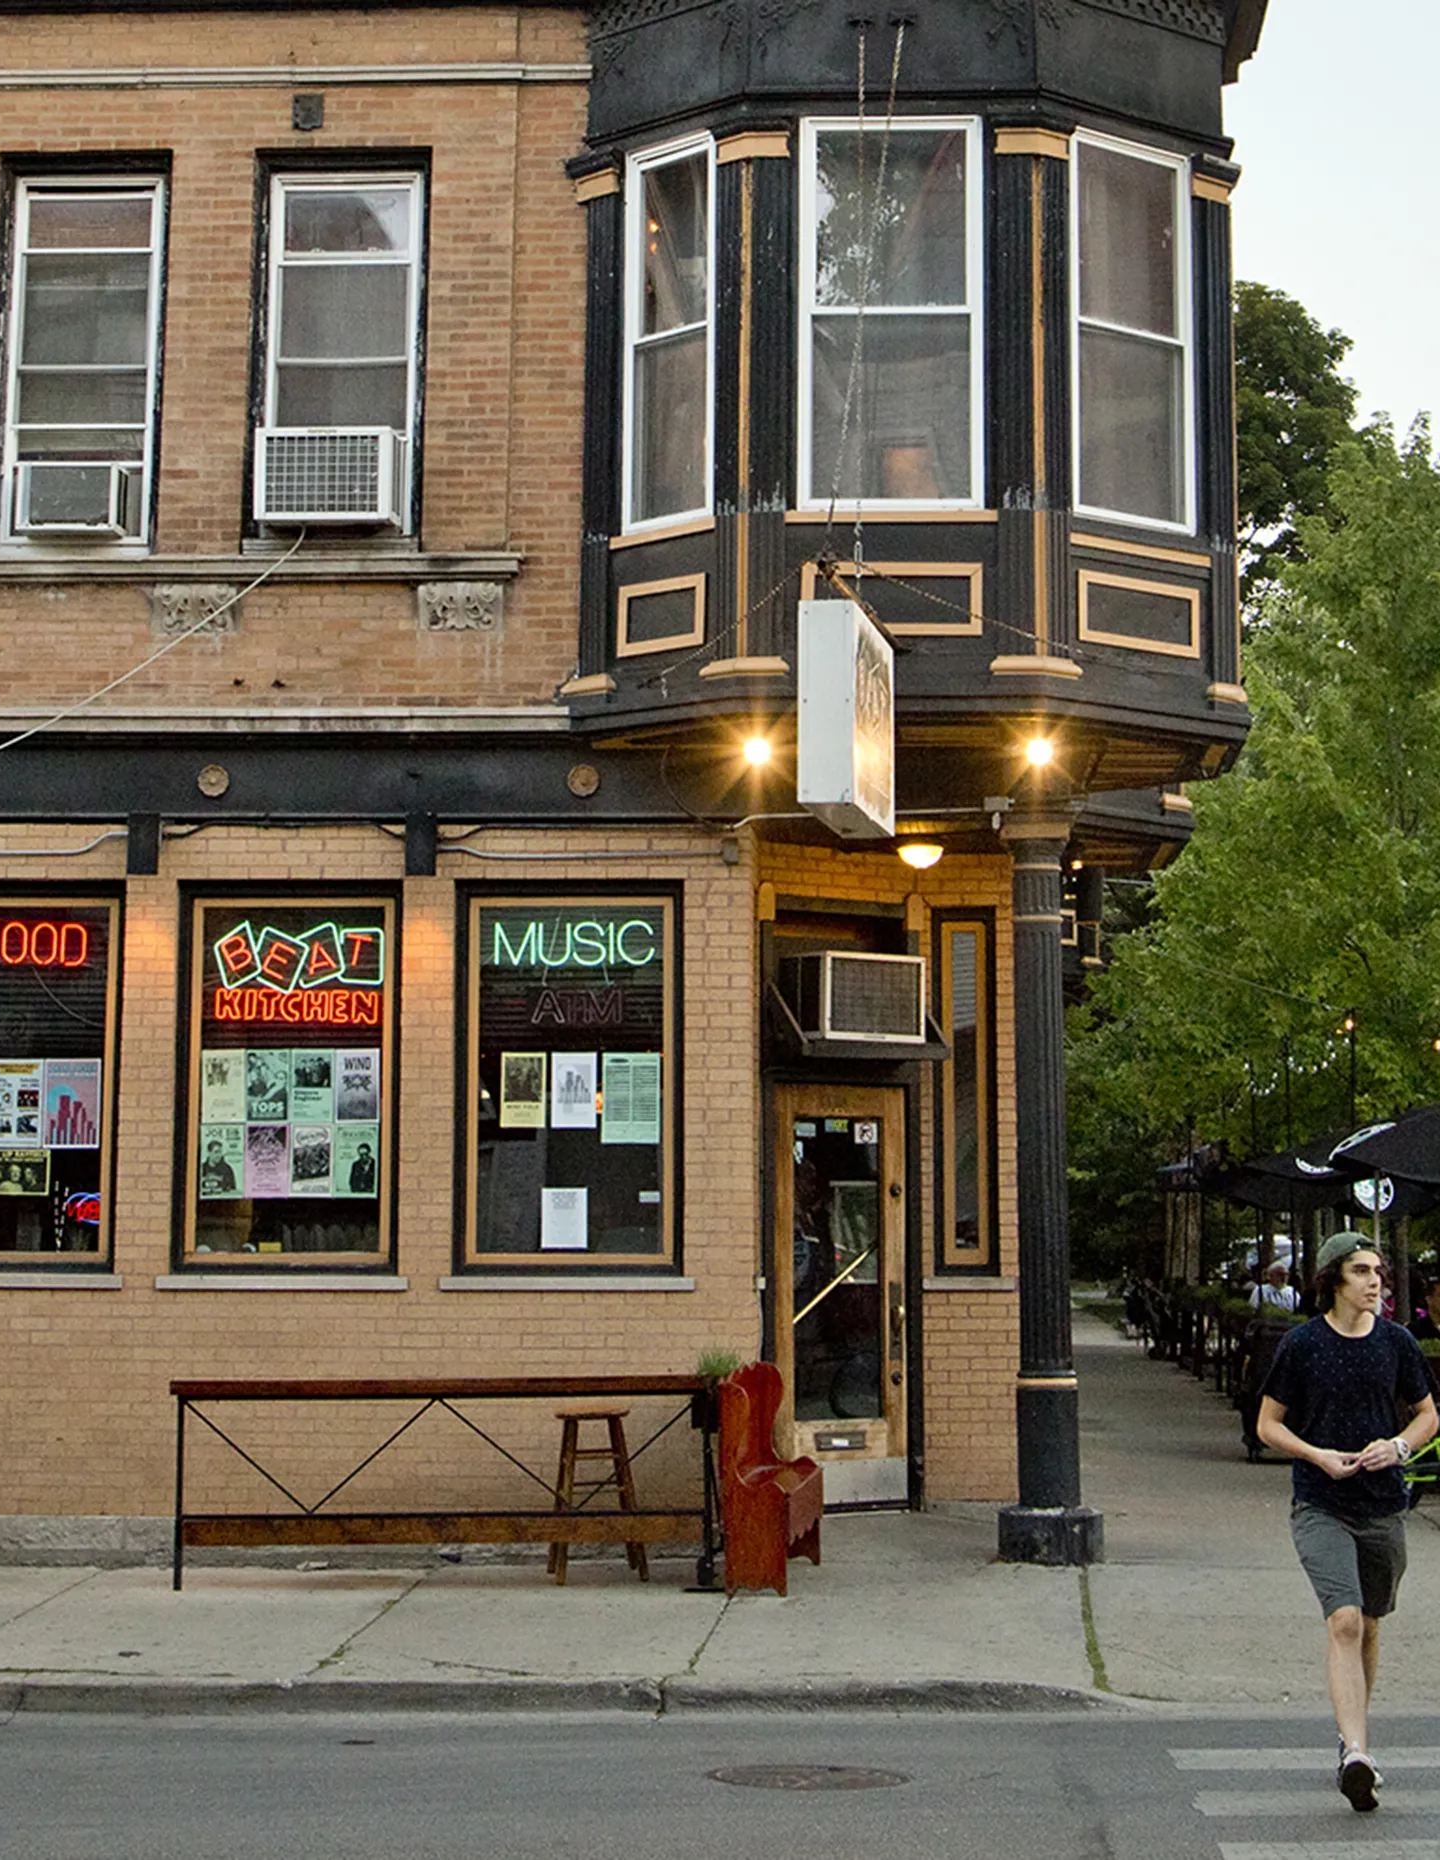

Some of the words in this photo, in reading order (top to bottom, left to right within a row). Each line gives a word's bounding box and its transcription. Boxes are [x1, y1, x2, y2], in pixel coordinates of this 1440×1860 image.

[219, 932, 374, 981] BEAT
[493, 919, 656, 967] MUSIC
[215, 986, 380, 1026] KITCHEN
[531, 989, 623, 1025] ATM
[251, 1101, 285, 1113] TOPS
